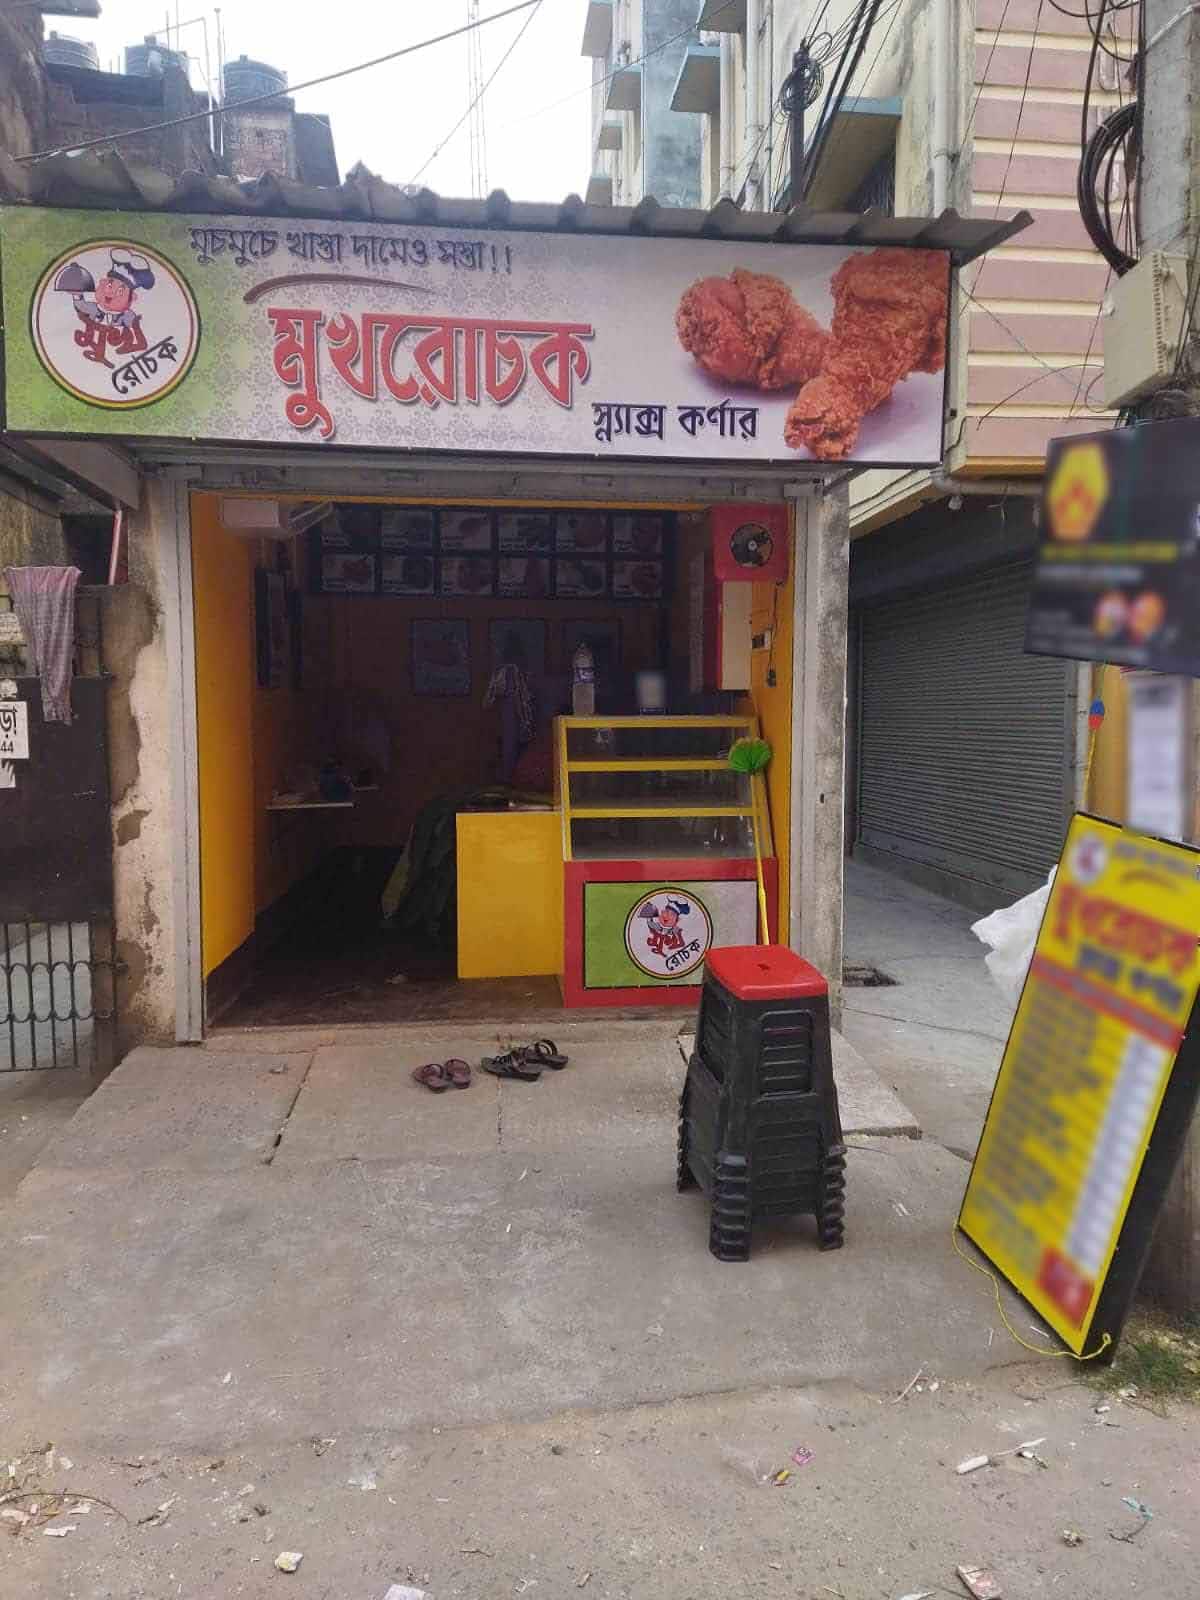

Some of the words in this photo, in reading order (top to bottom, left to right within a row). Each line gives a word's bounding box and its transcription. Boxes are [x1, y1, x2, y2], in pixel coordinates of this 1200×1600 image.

[188, 227, 279, 267] মুচমুচে
[286, 231, 344, 264] খাস্তা
[350, 234, 430, 269] দামেও
[111, 335, 178, 394] রোচক
[267, 307, 595, 440] মুখরোচক
[677, 398, 760, 440] কর্ণার
[666, 938, 701, 970] রোচক
